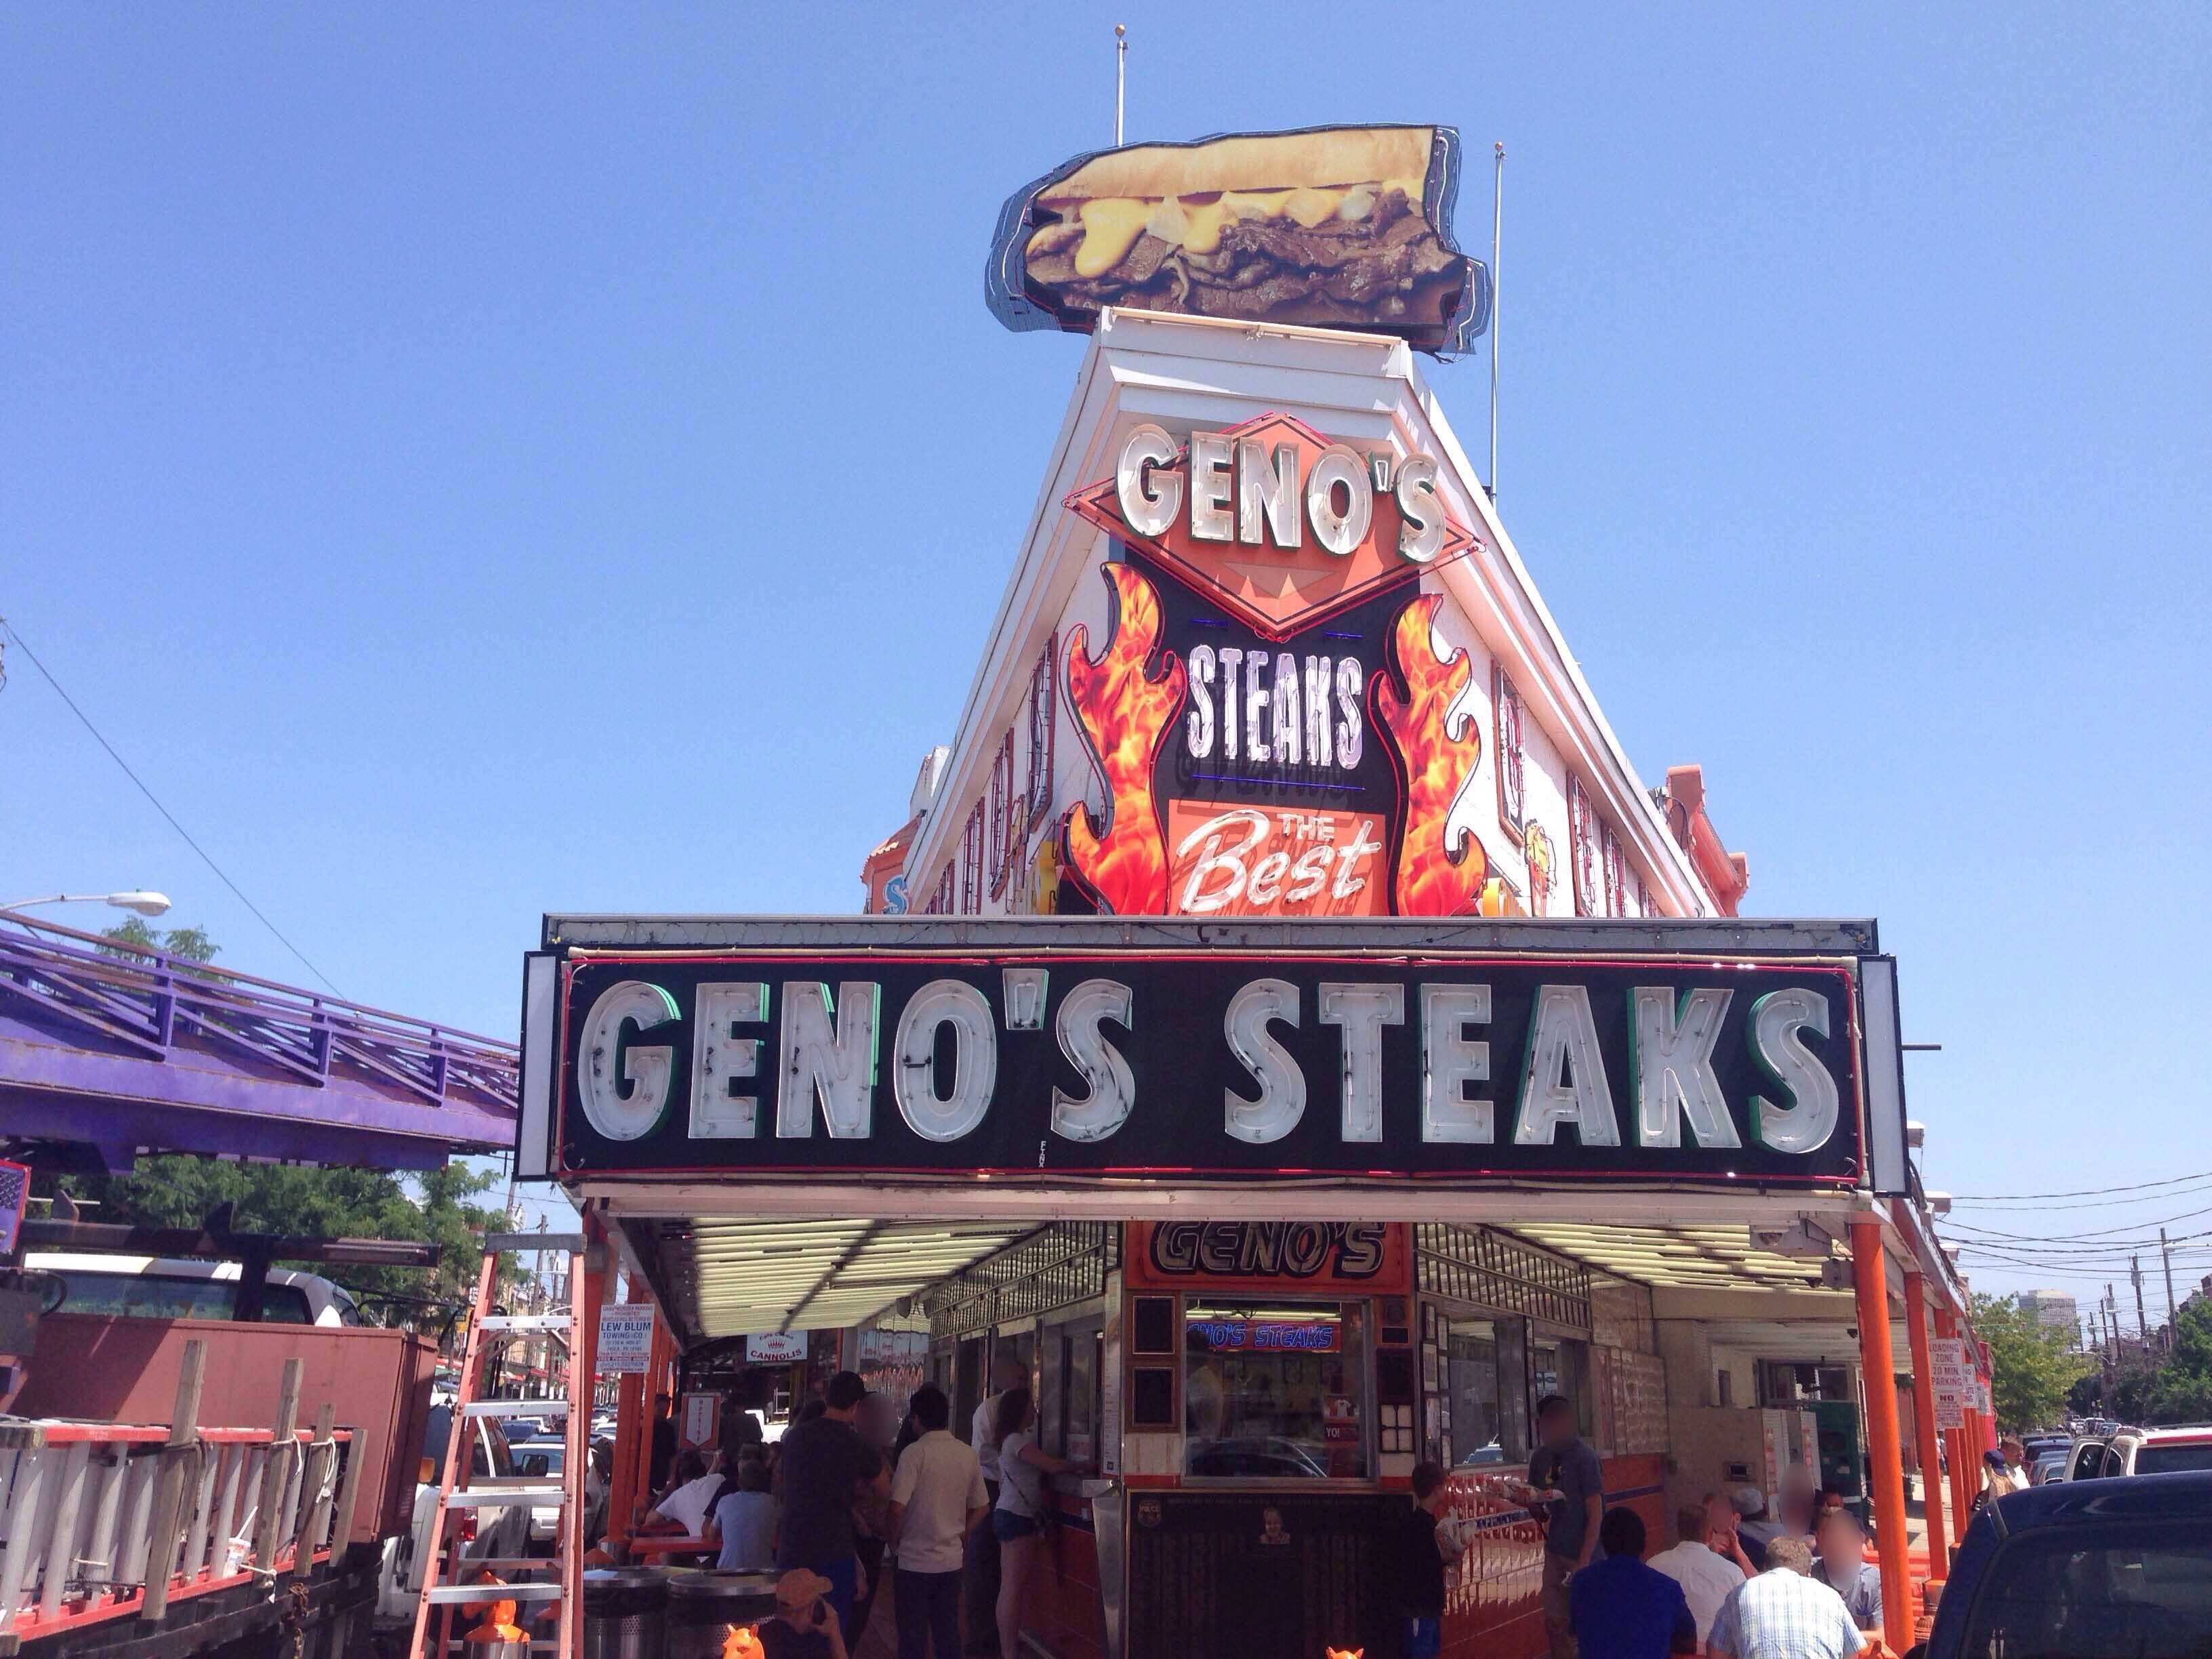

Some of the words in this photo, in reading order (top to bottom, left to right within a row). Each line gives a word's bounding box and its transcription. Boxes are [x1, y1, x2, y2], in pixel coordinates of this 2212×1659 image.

[1115, 424, 1448, 565] GENO'S
[1187, 644, 1363, 770] STEAKS
[1277, 813, 1335, 842] THE
[1176, 808, 1382, 913] Best
[577, 968, 1135, 1143] GENO'S
[1224, 978, 1839, 1154] STEAKS
[1152, 1221, 1387, 1275] GENO'S
[601, 1322, 621, 1331] LEW
[624, 1322, 651, 1331] BLUM
[1254, 1324, 1334, 1348] STEAKS
[750, 1349, 802, 1360] CANNOLIS
[1929, 1344, 1959, 1352] LOADING
[1936, 1354, 1954, 1362] ZONE
[1933, 1366, 1942, 1375] 20
[1931, 1377, 1962, 1387] PARKING
[1326, 1427, 1340, 1437] YO!
